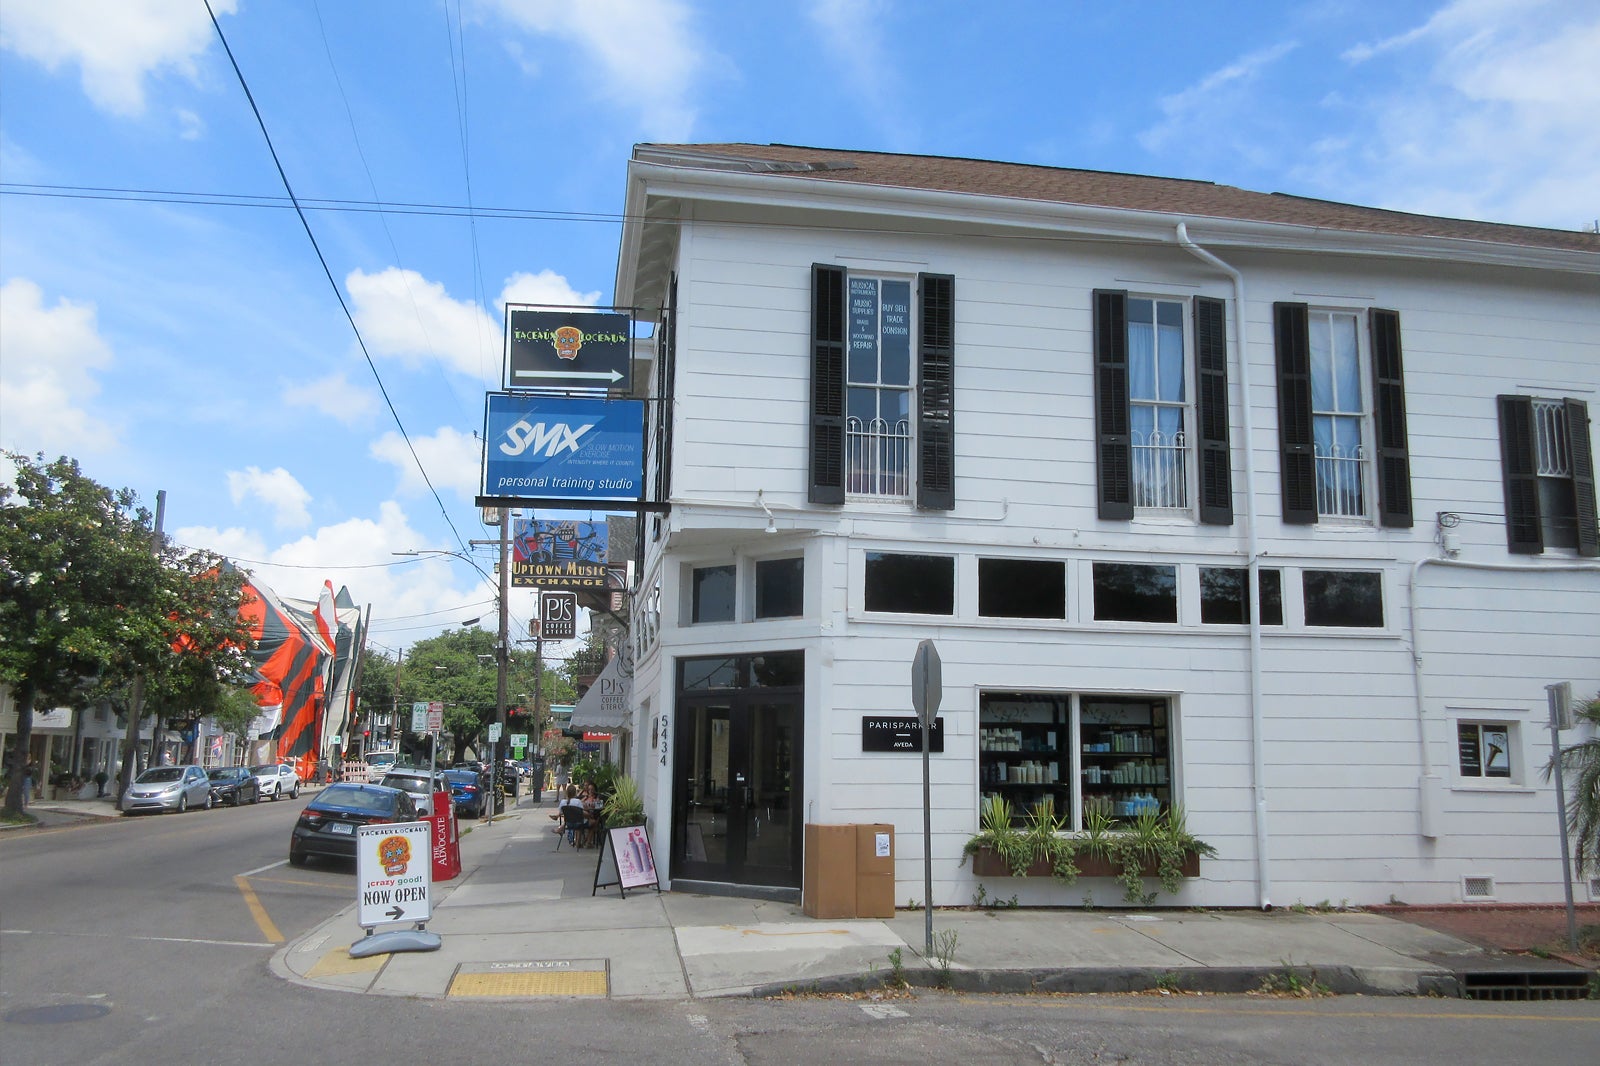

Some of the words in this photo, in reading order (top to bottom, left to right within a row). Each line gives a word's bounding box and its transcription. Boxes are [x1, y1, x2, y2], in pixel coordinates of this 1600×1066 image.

[851, 281, 875, 290] MUSICAL
[854, 299, 872, 308] MUSIC
[852, 307, 874, 315] SUPPLIES
[882, 304, 893, 312] BUY
[895, 305, 907, 313] SELL
[886, 315, 903, 324] TRADE
[883, 326, 908, 335] CONSIGN
[854, 341, 872, 349] REPAIR
[500, 420, 594, 457] SMX
[498, 476, 549, 488] personal
[552, 477, 595, 491] training
[599, 478, 633, 489] studio
[514, 577, 604, 586] EXCHANGE
[869, 721, 937, 730] PARISPARKR
[661, 715, 669, 767] 5434
[438, 816, 447, 866] ADVOCATE
[397, 876, 422, 885] good!
[364, 890, 391, 906] NOW
[395, 886, 426, 903] OPEN
